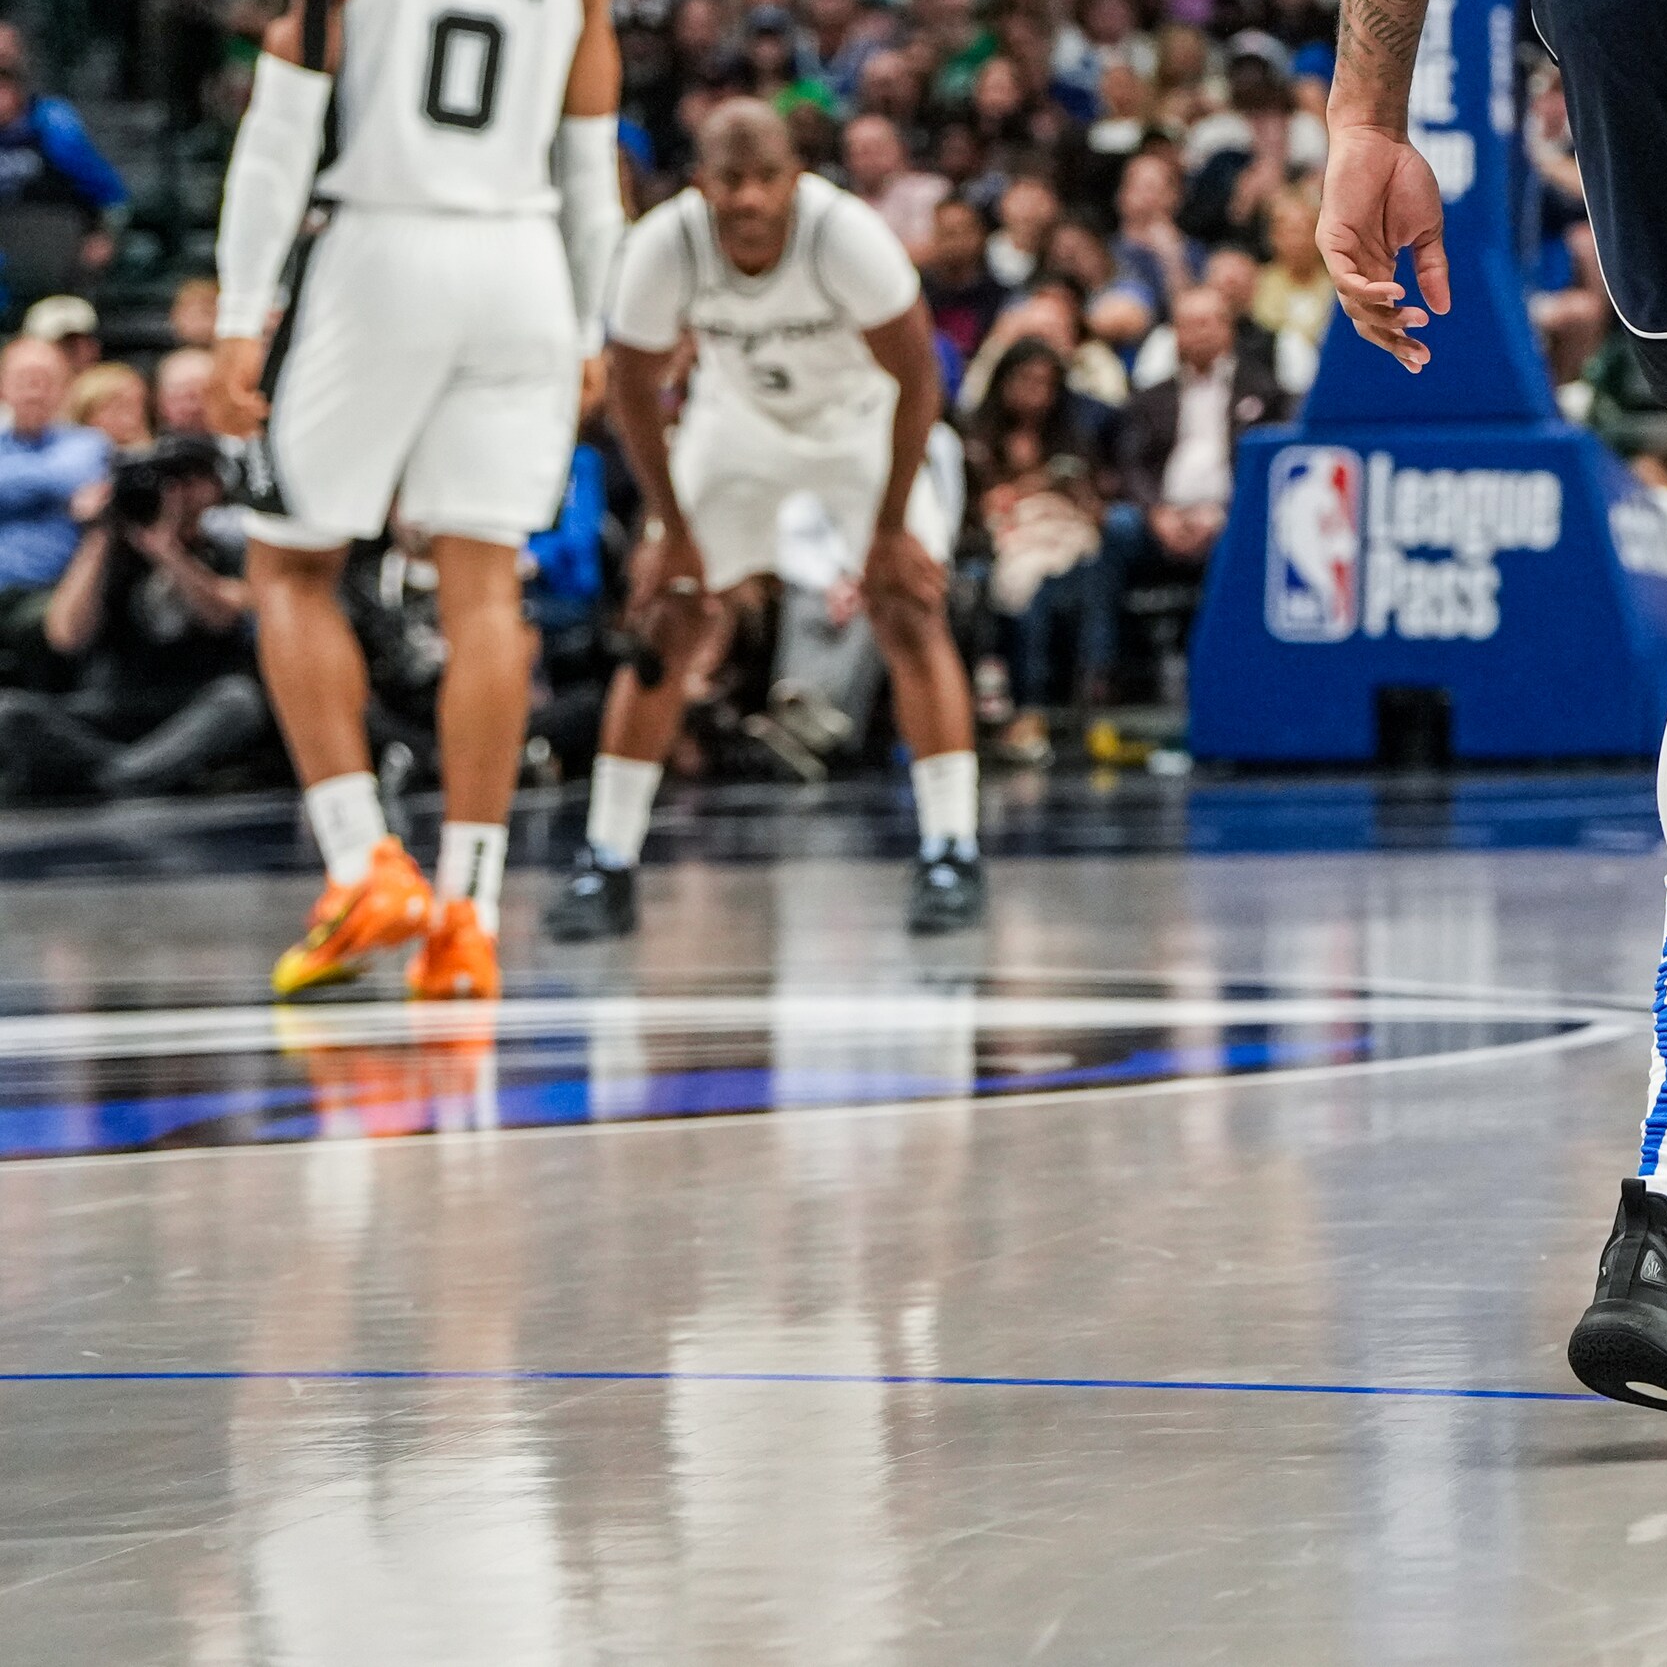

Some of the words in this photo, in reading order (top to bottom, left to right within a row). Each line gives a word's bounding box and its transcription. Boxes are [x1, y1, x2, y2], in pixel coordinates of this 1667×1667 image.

[424, 14, 504, 130] 0
[1368, 449, 1563, 570] League
[1363, 550, 1501, 641] Pass
